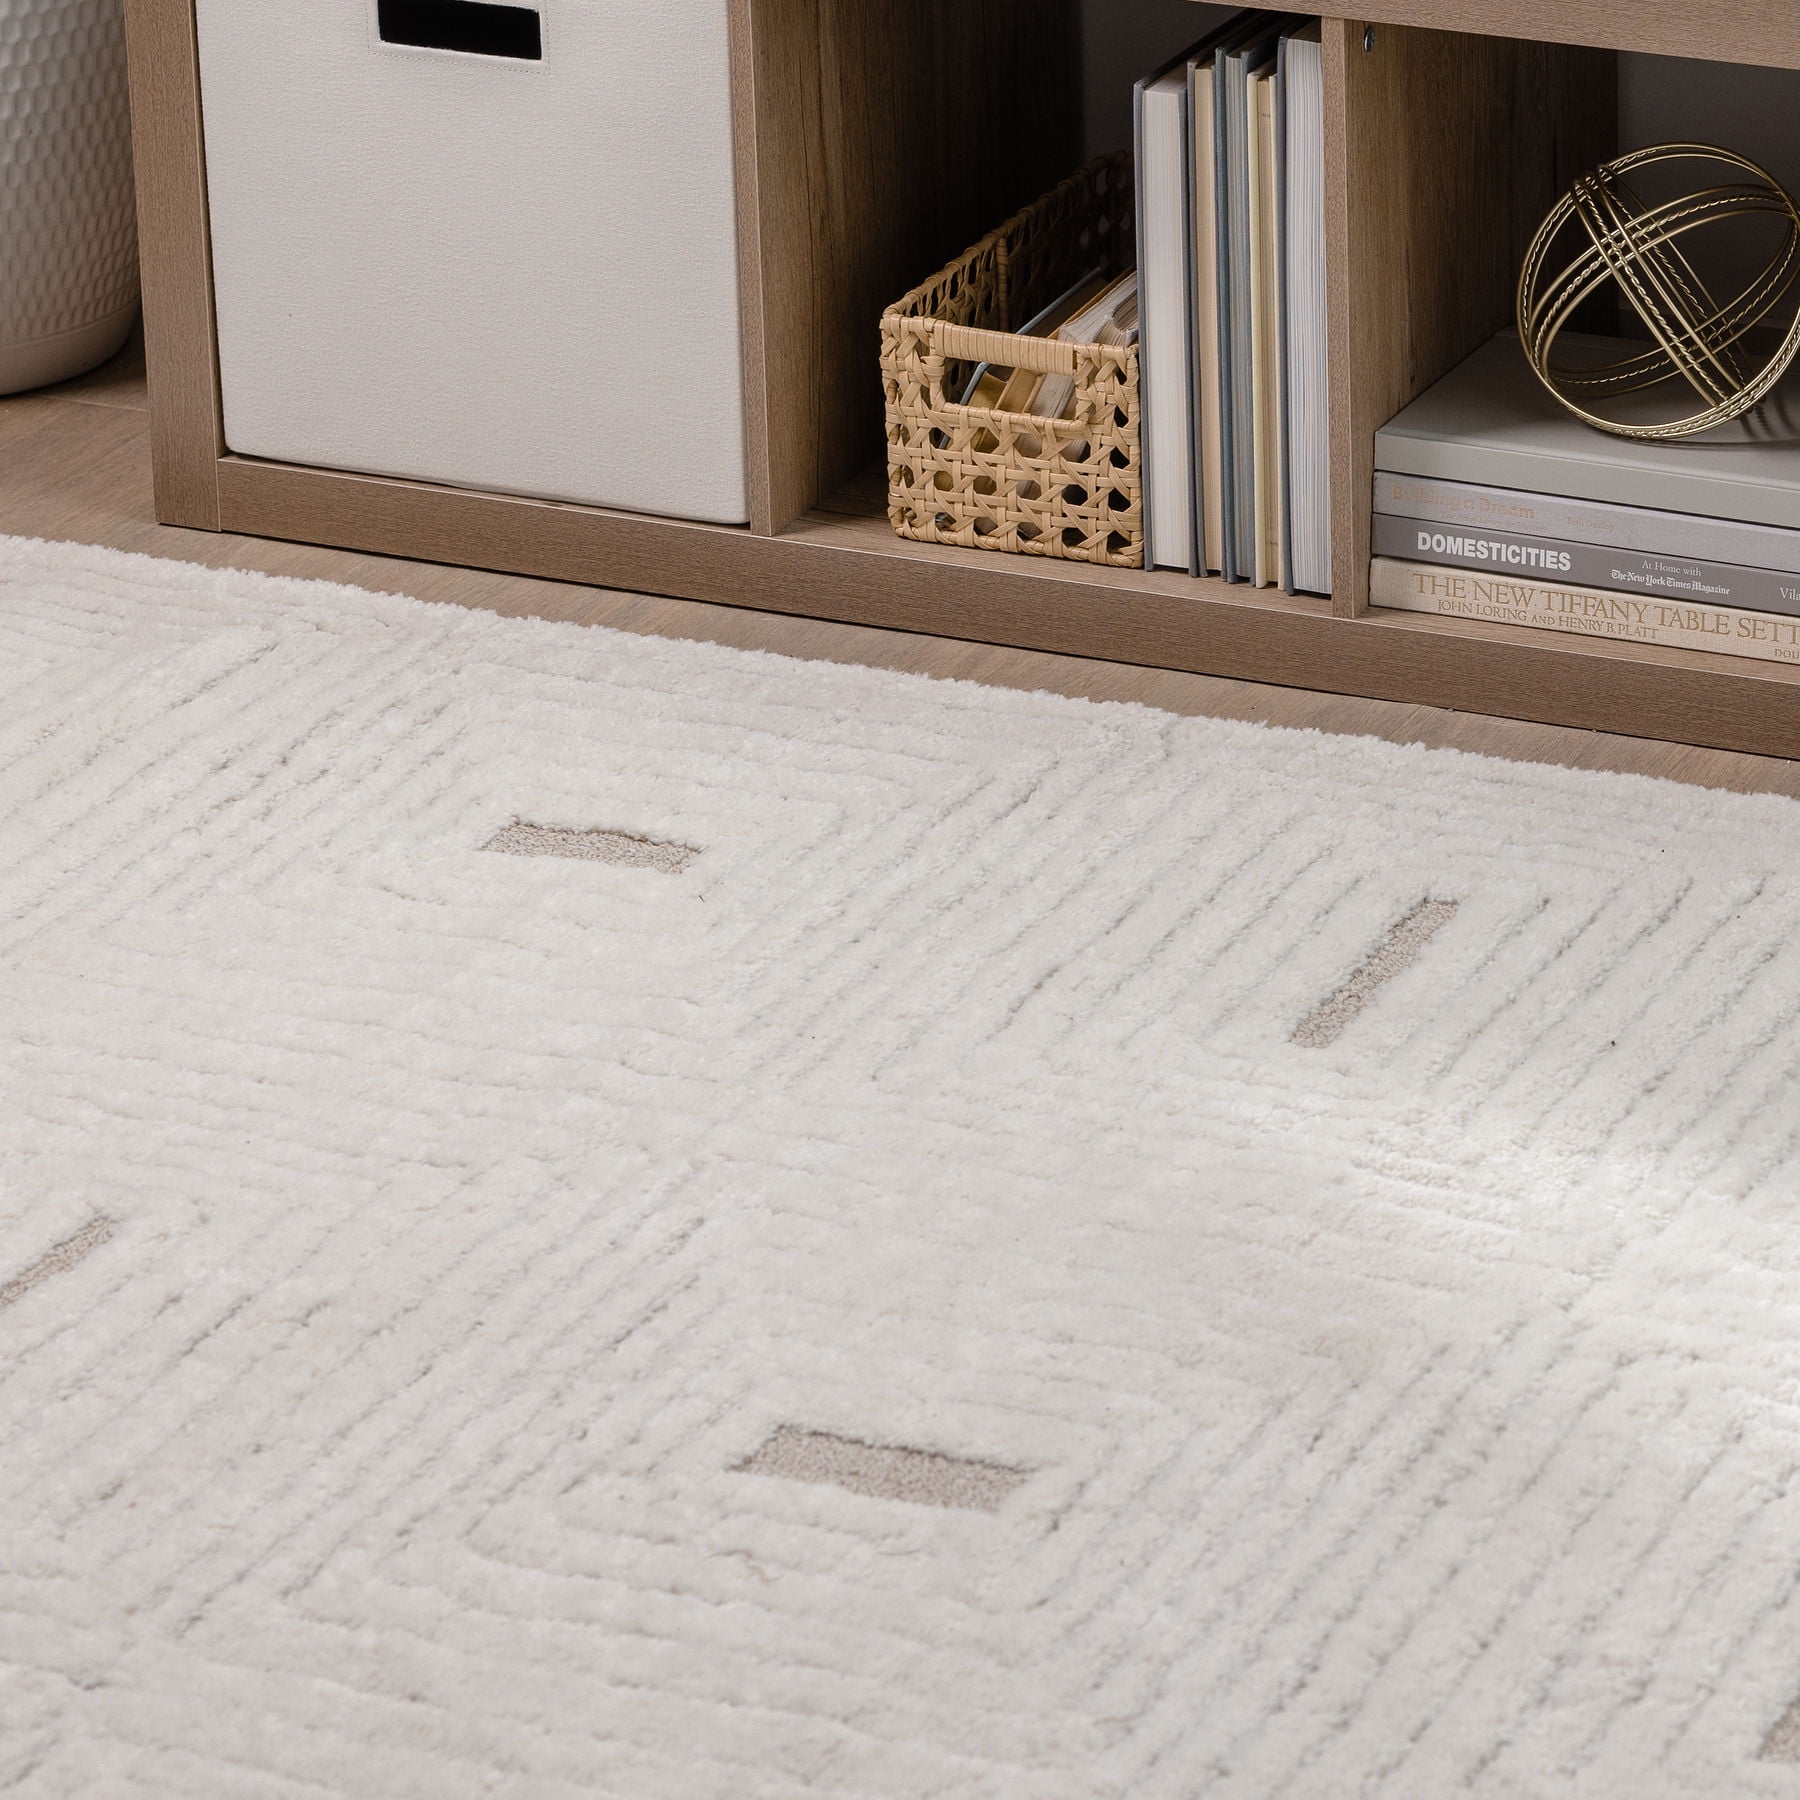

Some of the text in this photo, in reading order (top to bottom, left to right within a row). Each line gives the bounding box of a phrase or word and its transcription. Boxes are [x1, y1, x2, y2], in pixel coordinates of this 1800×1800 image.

[1417, 531, 1571, 572] DOMESTICITIES
[1642, 560, 1702, 577] At Home with
[1611, 569, 1731, 596] The New York Times Magazine
[1412, 572, 1467, 599] THE
[1473, 580, 1536, 609] NEW
[1540, 589, 1650, 624] TIFFANY
[1654, 605, 1731, 636] TABLE
[1437, 599, 1473, 614] JOHN
[1476, 602, 1527, 622] LORING
[1558, 615, 1604, 633] HENRY
[1606, 622, 1617, 634] B.
[1618, 624, 1660, 640] PLATT
